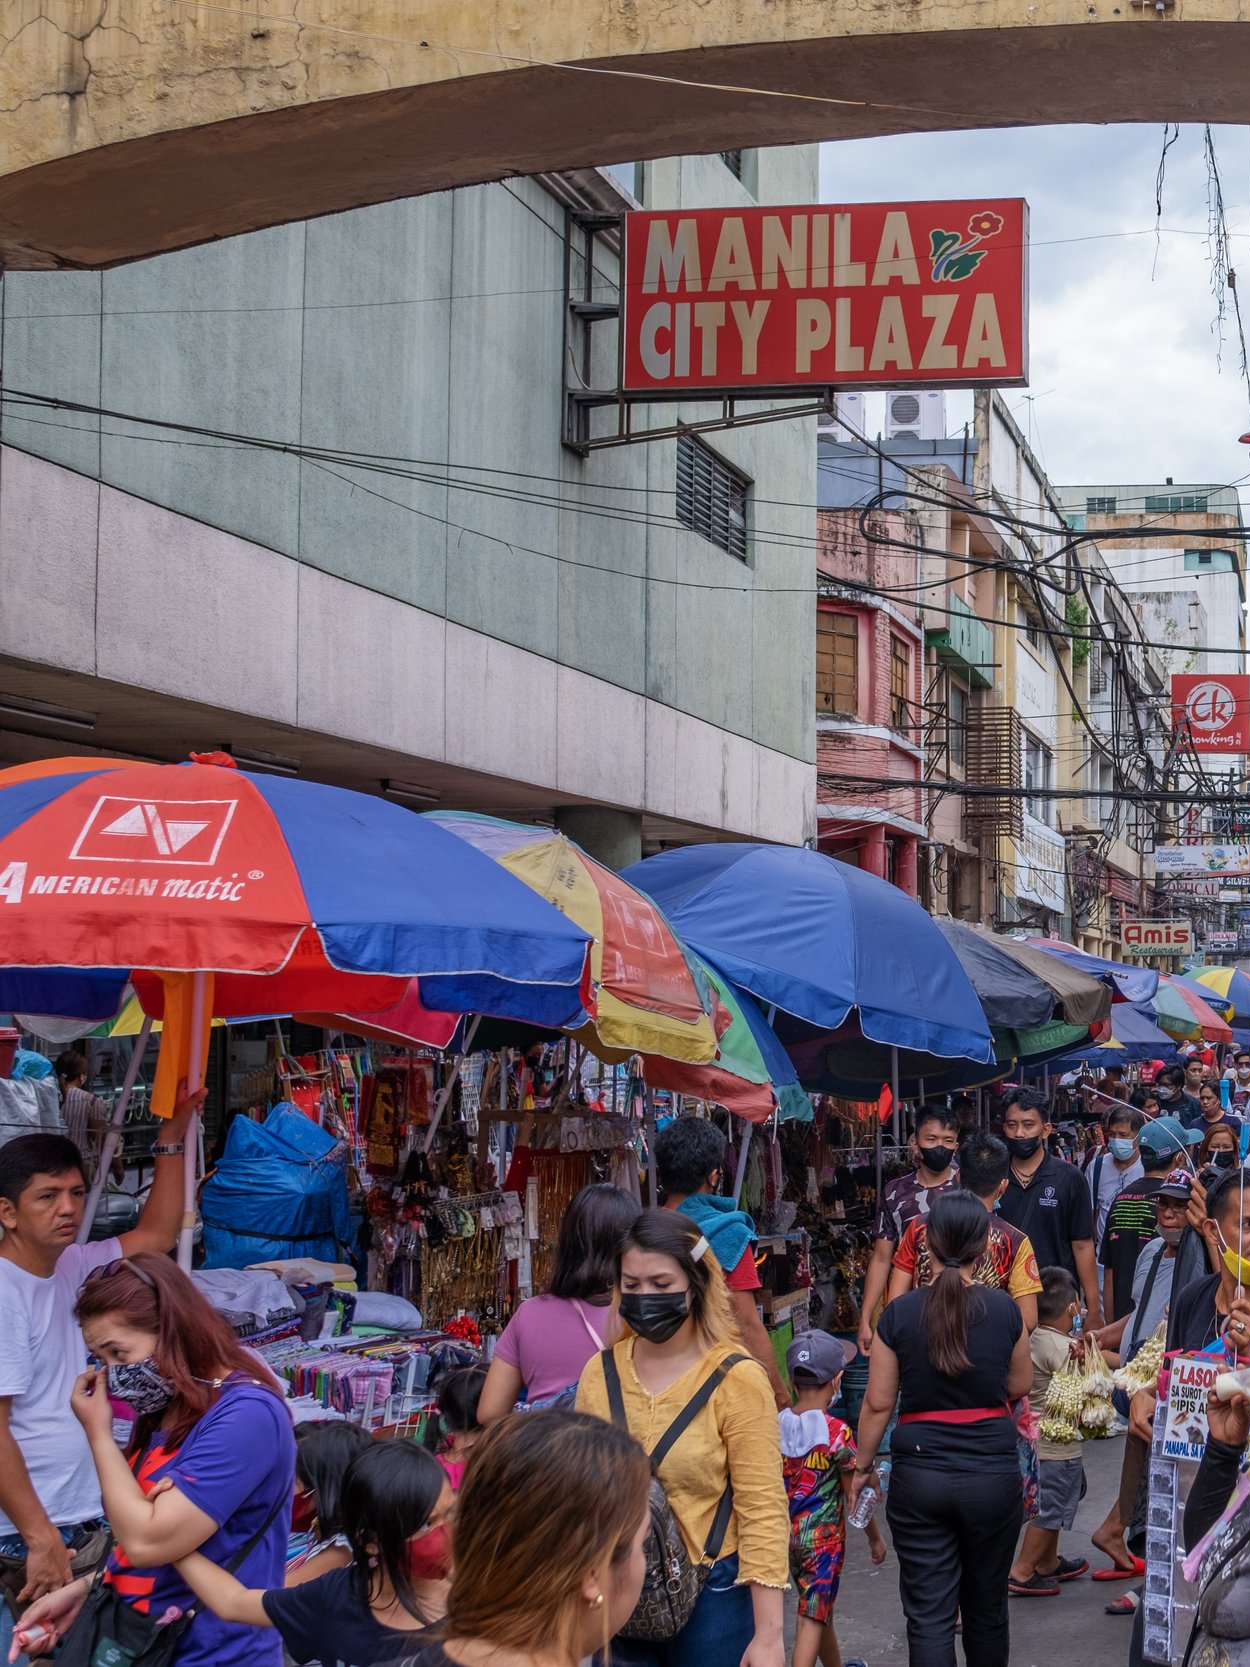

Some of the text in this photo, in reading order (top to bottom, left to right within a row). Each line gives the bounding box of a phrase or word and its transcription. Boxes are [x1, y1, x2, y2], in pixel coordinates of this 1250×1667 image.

[641, 211, 921, 294] MANILA
[639, 293, 1007, 380] CITY PLAZA
[0, 861, 158, 904] AMERICAN
[1124, 925, 1189, 945] Amis
[1129, 944, 1184, 955] Restaurant
[1171, 1385, 1202, 1399] SA SUROT
[1176, 1400, 1195, 1413] IPIS
[1164, 1441, 1189, 1457] PANAPAL
